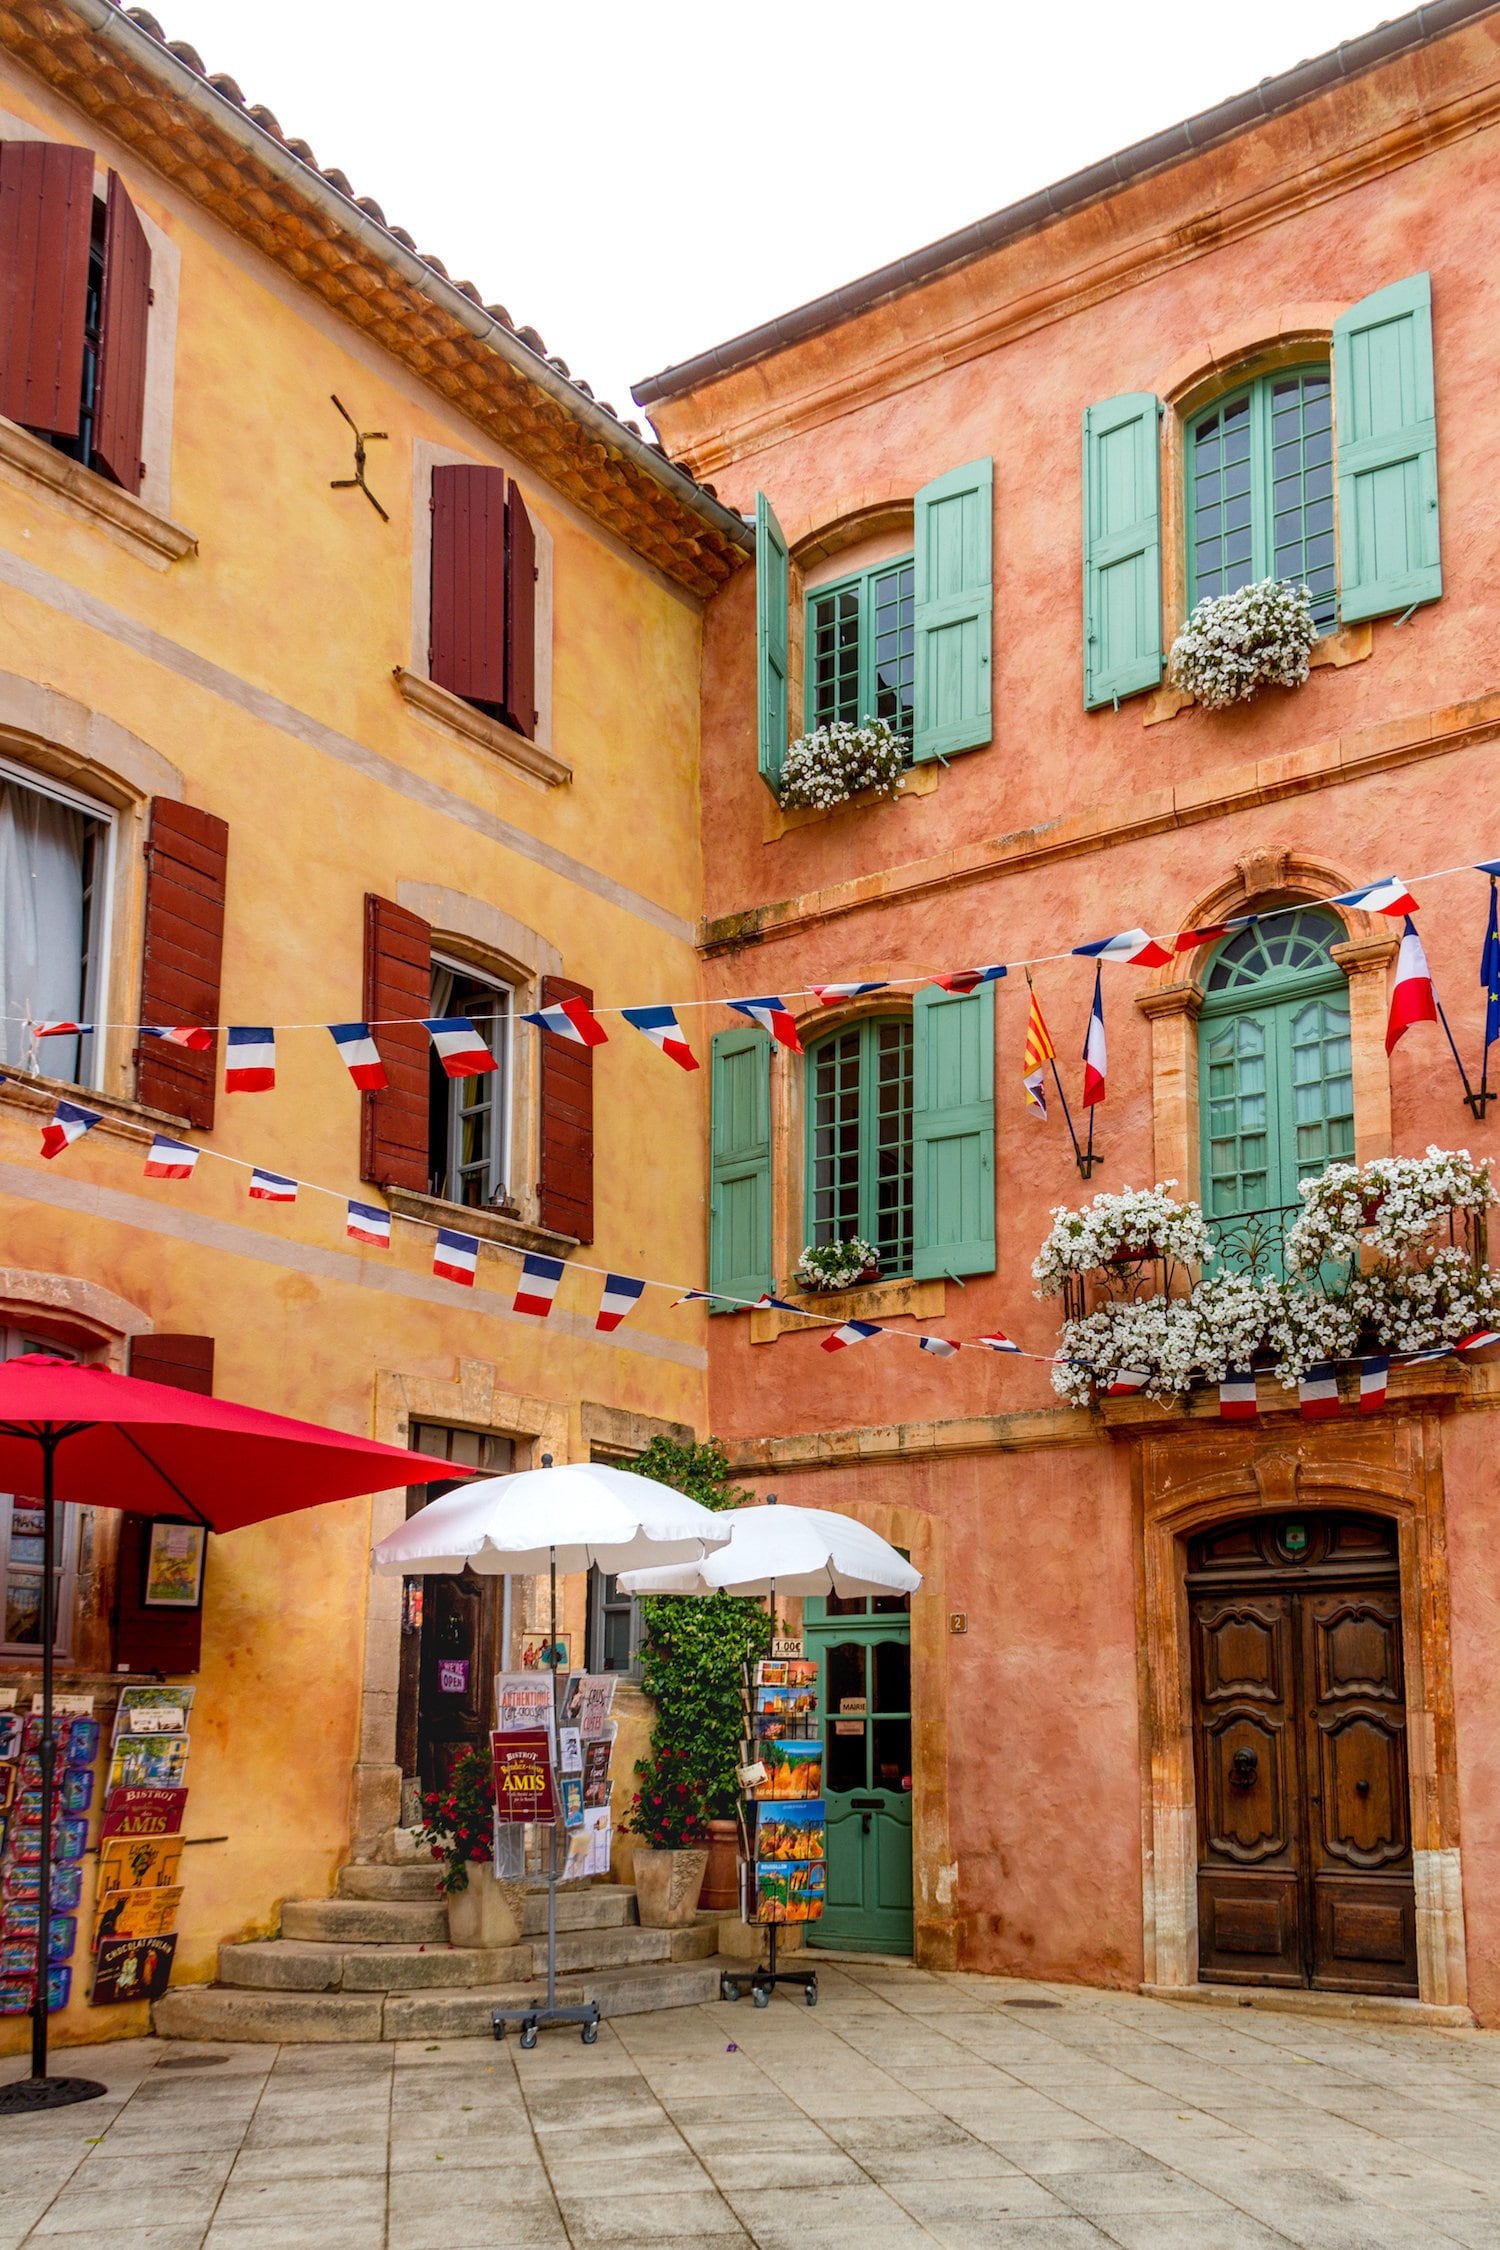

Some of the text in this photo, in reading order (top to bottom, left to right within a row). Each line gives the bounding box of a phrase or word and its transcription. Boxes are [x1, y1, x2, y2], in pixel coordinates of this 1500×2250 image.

[954, 1616, 961, 1629] 2
[443, 1674, 462, 1688] OPEN
[842, 1703, 866, 1711] MAIRIE
[506, 1751, 538, 1762] BISTROT
[501, 1774, 546, 1791] AMIS
[125, 1789, 176, 1801] BISTROT
[115, 1815, 168, 1832] AMIS
